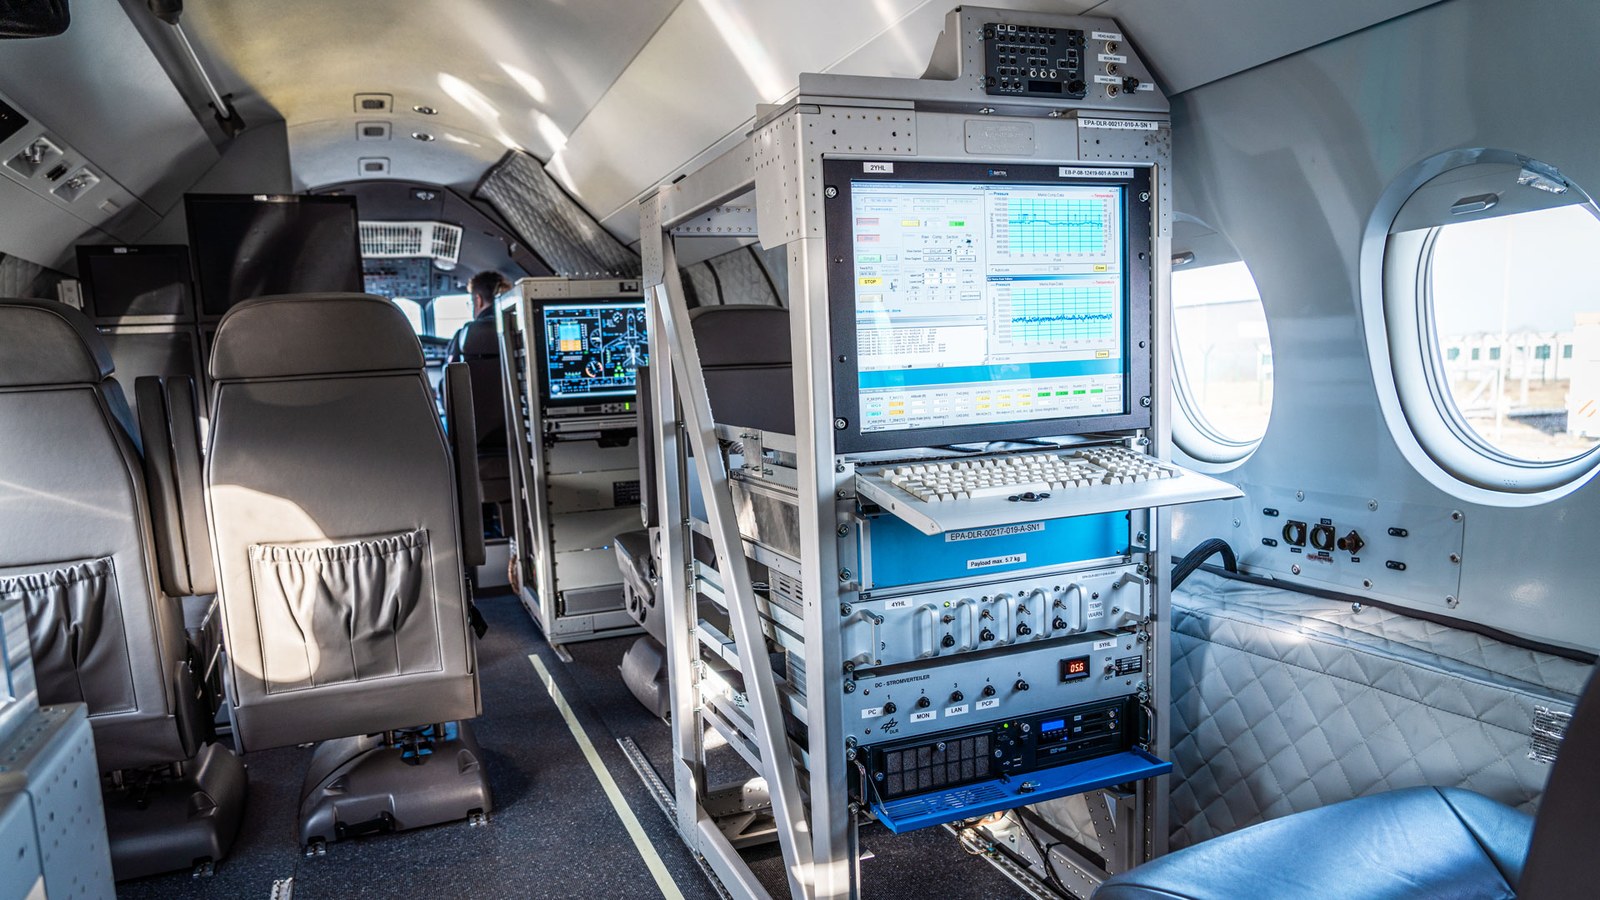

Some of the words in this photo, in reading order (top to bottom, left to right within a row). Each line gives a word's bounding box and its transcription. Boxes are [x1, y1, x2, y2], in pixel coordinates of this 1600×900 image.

[950, 523, 1041, 541] EPA-DLR-00217-019-A-SN1
[970, 559, 991, 568] Payload
[886, 674, 930, 687] STROMVERTEILER
